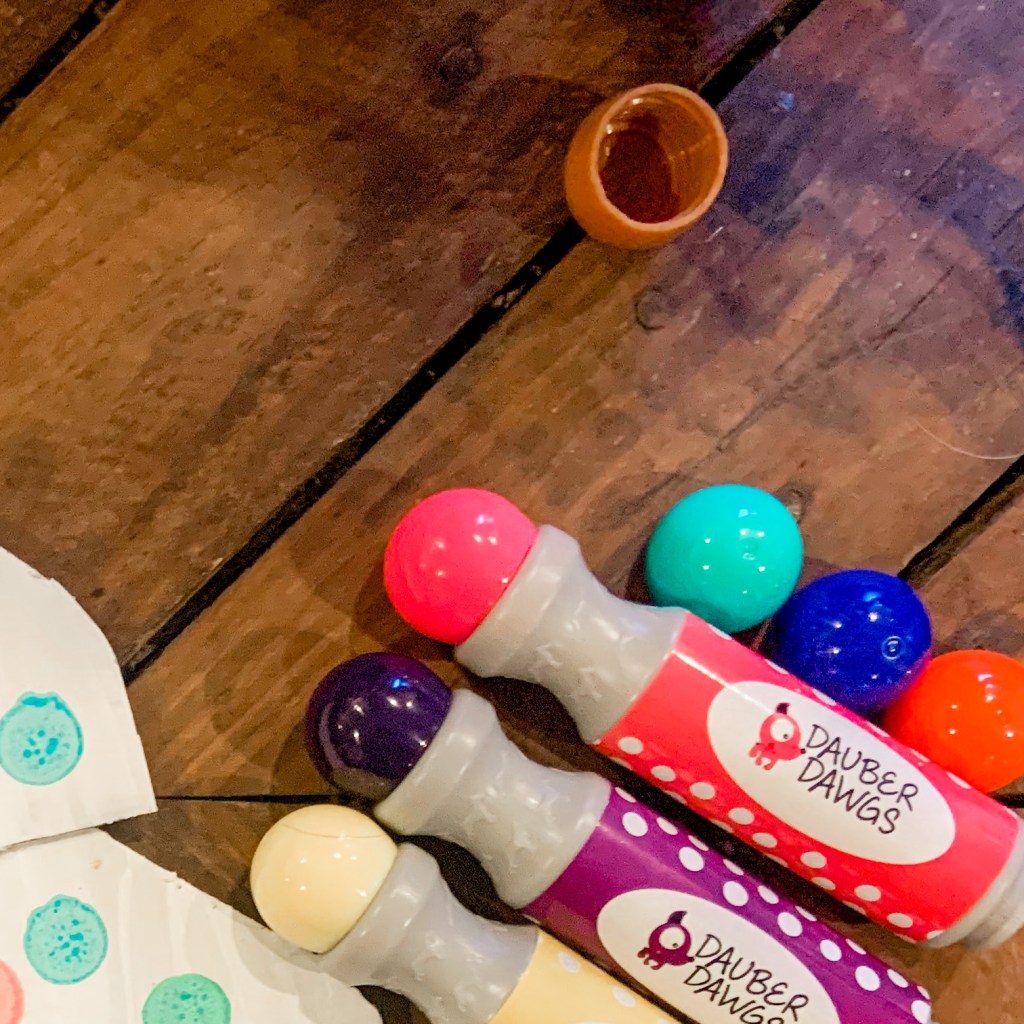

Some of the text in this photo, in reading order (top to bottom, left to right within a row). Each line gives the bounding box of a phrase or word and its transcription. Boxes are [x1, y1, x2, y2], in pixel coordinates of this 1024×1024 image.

[796, 756, 901, 835] DAWGS
[805, 723, 919, 812] DAUBER
[694, 933, 809, 1022] DAUBER
